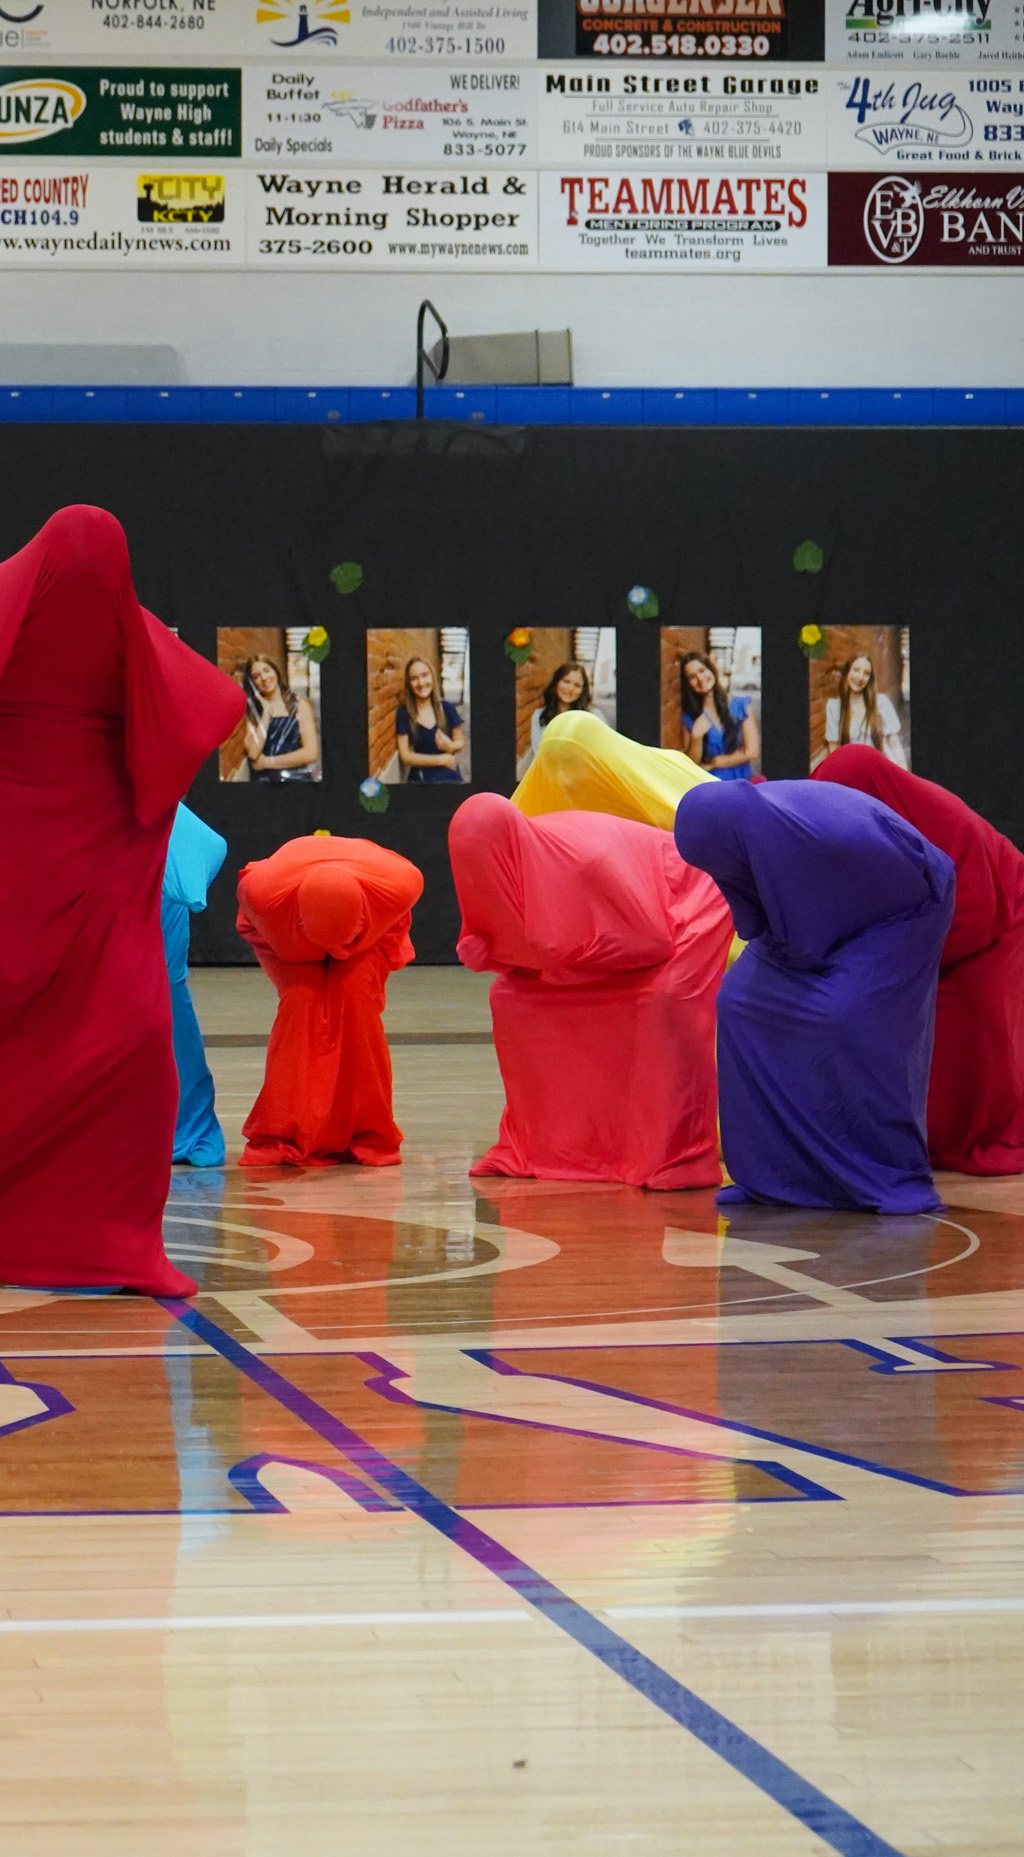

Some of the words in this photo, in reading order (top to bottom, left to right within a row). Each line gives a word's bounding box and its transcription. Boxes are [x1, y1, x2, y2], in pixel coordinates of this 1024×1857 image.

[193, 0, 216, 11] NE
[362, 6, 426, 20] Independent
[429, 6, 450, 17] and
[455, 6, 493, 18] Assisted
[495, 6, 528, 20] Living
[103, 14, 205, 30] 402-844-2680
[582, 19, 659, 32] CONCRETE
[662, 19, 674, 32] &
[676, 20, 782, 33] CONSTRUCTION
[386, 36, 505, 55] 402-375-1500
[593, 33, 771, 57] 402.518.0330
[848, 32, 990, 44] 402-375-2511
[272, 73, 315, 88] Daily
[450, 74, 469, 90] WE
[471, 74, 521, 90] DELIVER!
[546, 74, 611, 94] Main
[623, 74, 711, 94] Street
[723, 75, 819, 96] Garage
[969, 79, 1011, 93] 1005
[99, 78, 145, 97] Proud
[149, 81, 166, 97] to
[170, 81, 230, 101] support
[267, 88, 320, 101] Buffet
[383, 98, 468, 113] Godfather's
[593, 100, 613, 113] Full
[623, 100, 664, 113] Service
[669, 101, 695, 113] Auto
[700, 101, 739, 116] Repair
[744, 101, 773, 116] Shop
[846, 77, 895, 123] 4th
[900, 81, 956, 124] Jug
[120, 103, 172, 124] Wayne
[177, 103, 212, 125] High
[382, 115, 424, 129] Pizza
[481, 117, 511, 127] Main
[99, 128, 166, 146] students
[171, 128, 184, 146] &
[188, 128, 233, 146] staff!
[563, 121, 583, 134] 614
[591, 121, 621, 134] Main
[626, 121, 669, 134] Street
[703, 121, 801, 137] 402-375-4420
[984, 125, 1024, 141] 833
[255, 138, 282, 154] Daily
[286, 137, 333, 155] Specials
[443, 143, 527, 156] 833-5077
[584, 144, 613, 158] PROUD
[616, 144, 661, 159] SPONSORS
[664, 144, 674, 159] OF
[678, 144, 692, 159] THE
[696, 144, 725, 159] WAYNE
[728, 144, 748, 159] BLUE
[753, 145, 782, 159] DEVILS
[897, 150, 932, 160] Great
[939, 150, 969, 160] Food
[975, 150, 984, 160] &
[989, 150, 1022, 160] Brick
[24, 173, 90, 209] COUNTRY
[256, 174, 362, 197] Wayne
[382, 175, 490, 195] Herald
[502, 176, 526, 195] &
[561, 177, 808, 228] TEAMMATES
[923, 184, 1004, 209] Elkhorn
[153, 210, 214, 222] KCTY
[265, 206, 389, 230] Morning
[407, 207, 520, 231] Shopper
[589, 220, 691, 231] MENTORING
[693, 220, 776, 231] PROGRAM
[259, 239, 373, 255] 375-2600
[388, 242, 529, 258] www.mywaynenews.com
[579, 234, 636, 248] Together
[646, 234, 666, 245] We
[676, 234, 744, 246] Transform
[753, 234, 788, 246] Lives
[625, 249, 741, 262] teammates.org
[969, 245, 991, 255] AND
[992, 245, 1022, 255] TRUST
